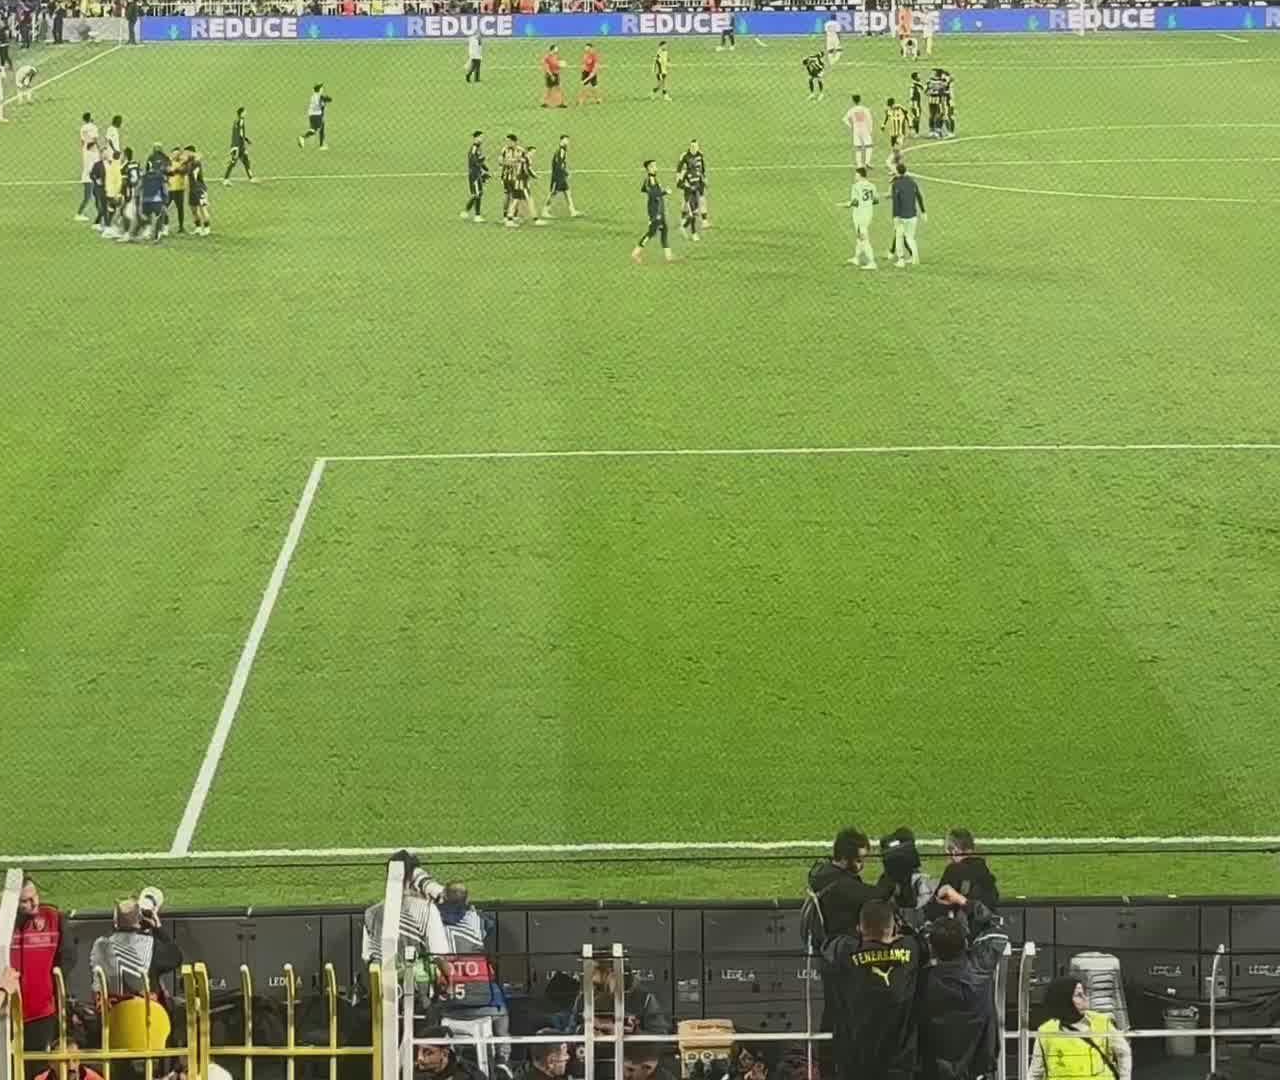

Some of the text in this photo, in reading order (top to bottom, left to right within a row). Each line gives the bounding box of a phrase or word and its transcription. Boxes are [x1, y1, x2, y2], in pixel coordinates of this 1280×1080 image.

[191, 17, 297, 39] REDUCE
[407, 16, 513, 37] REDUCE
[622, 13, 729, 34] REDUCE
[1049, 9, 1155, 29] REDUCE
[862, 188, 874, 202] 31
